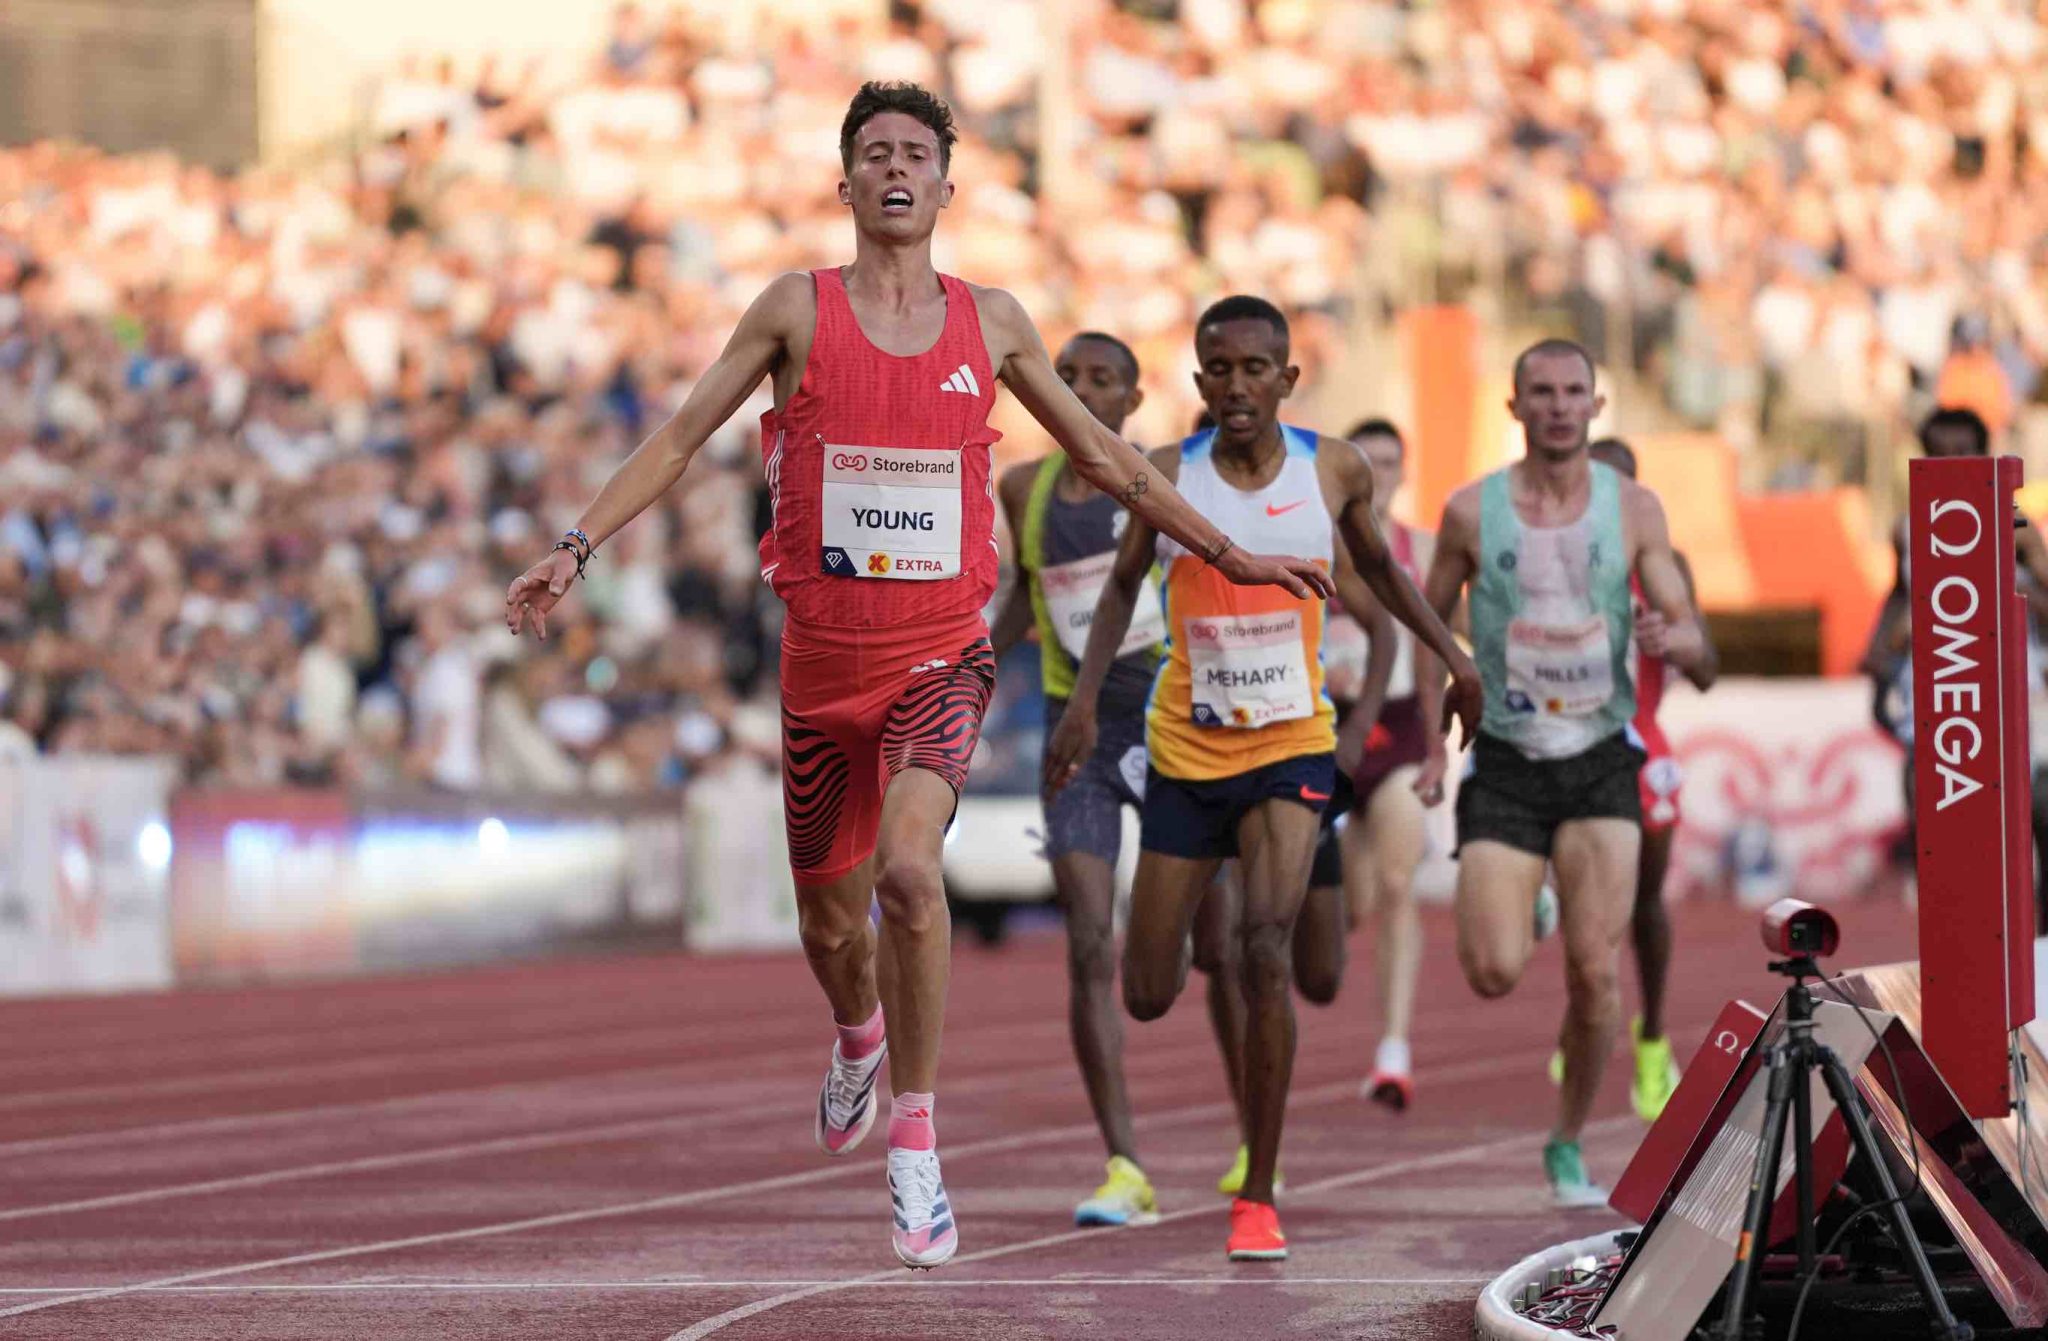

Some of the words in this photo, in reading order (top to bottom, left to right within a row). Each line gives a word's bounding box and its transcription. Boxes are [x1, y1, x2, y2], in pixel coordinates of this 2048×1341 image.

[872, 457, 954, 474] Storebrand
[851, 508, 934, 531] YOUNG
[895, 559, 943, 572] EXTRA
[1223, 618, 1296, 638] Storebrand
[1206, 664, 1287, 688] MEHARY
[1930, 576, 1985, 812] OMEGA
